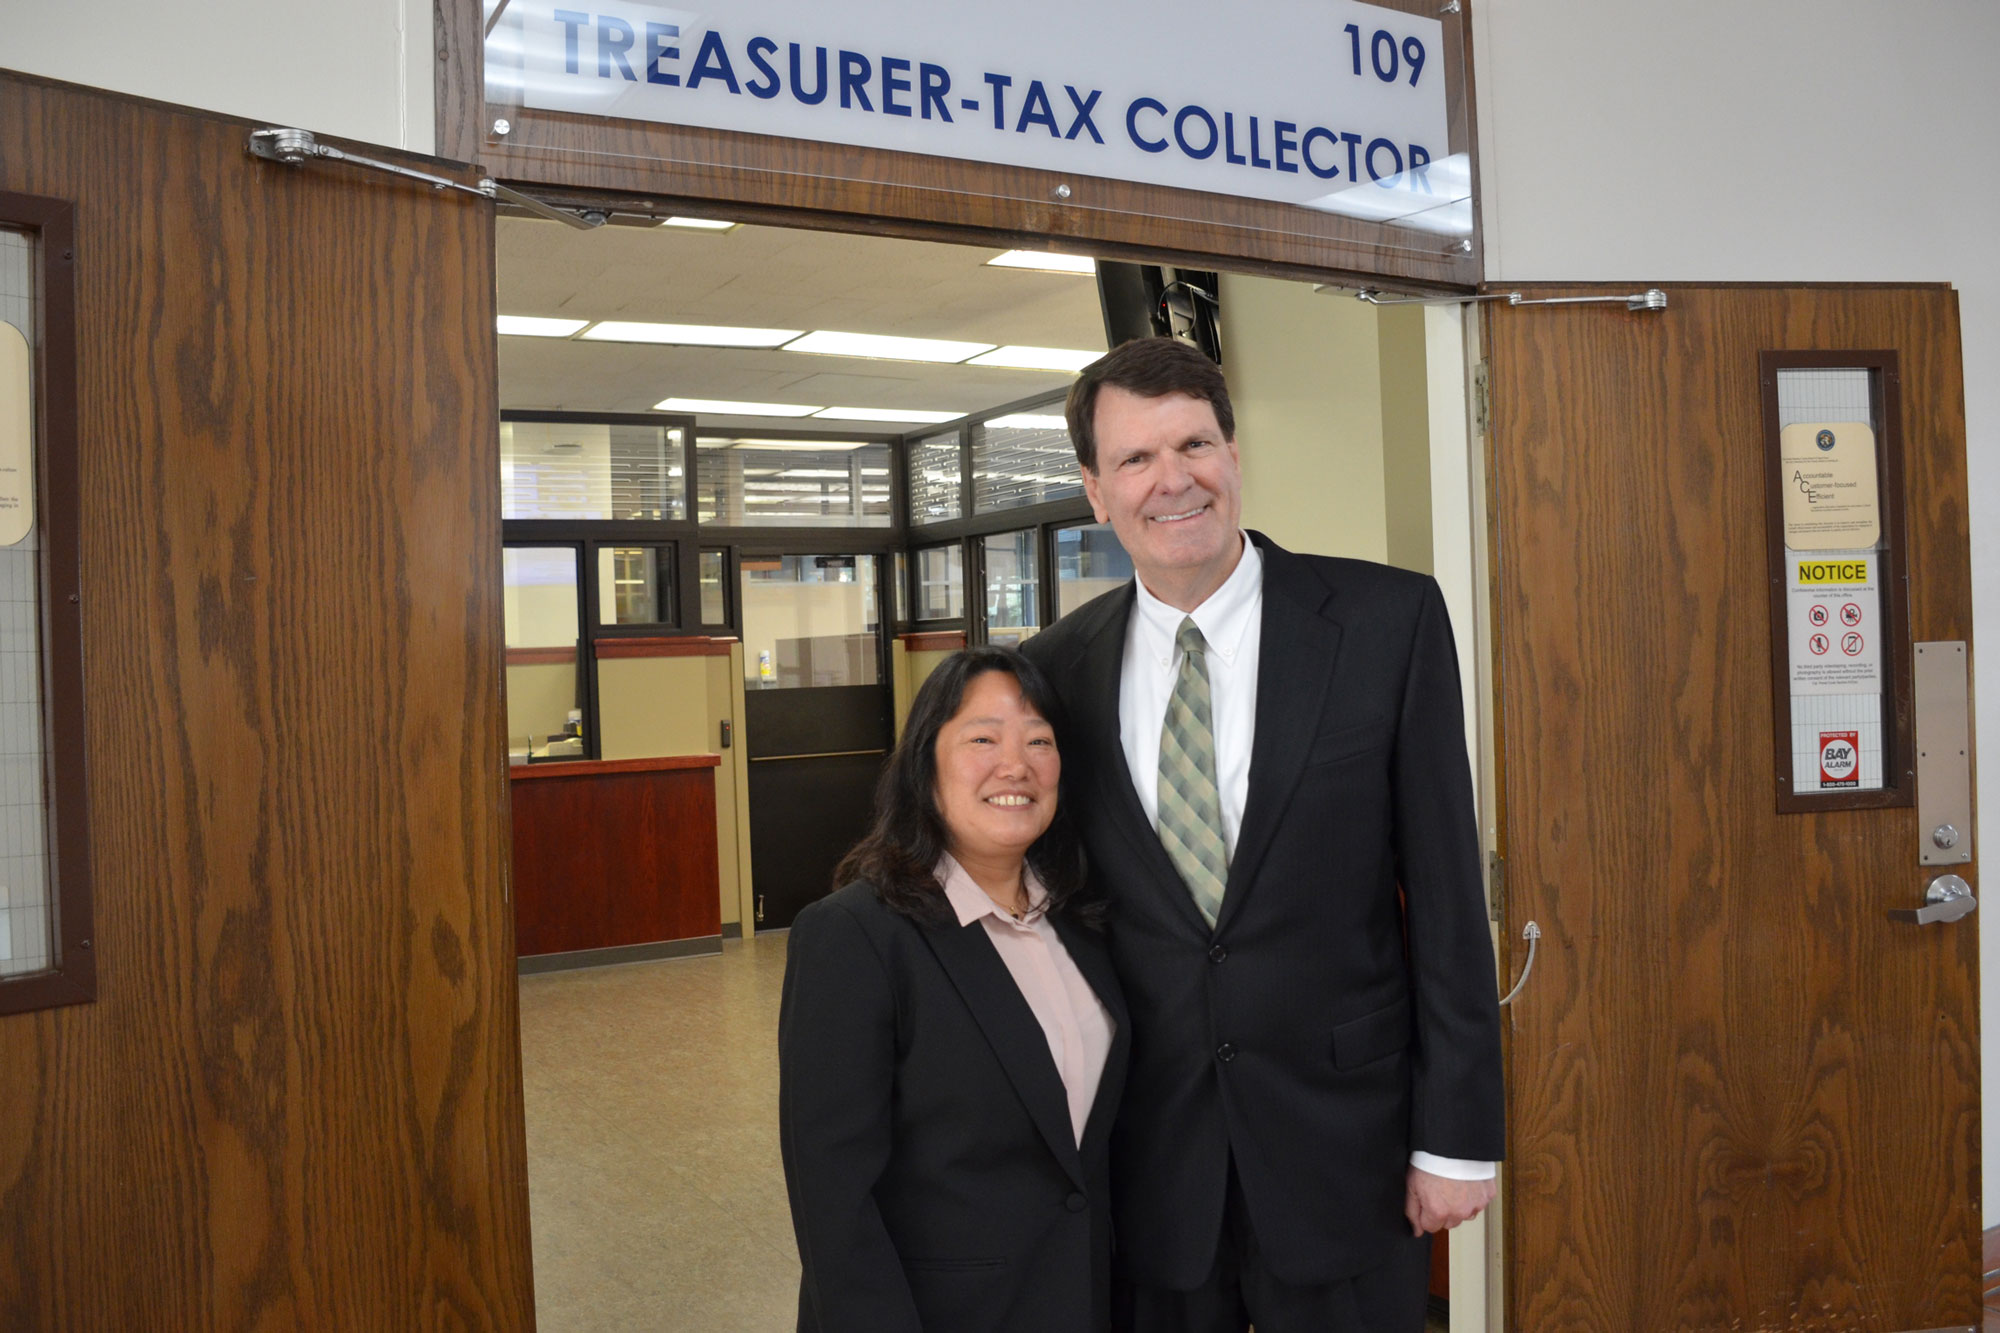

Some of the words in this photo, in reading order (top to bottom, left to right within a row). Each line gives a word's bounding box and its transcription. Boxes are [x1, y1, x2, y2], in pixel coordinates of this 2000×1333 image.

[1344, 23, 1426, 88] 109
[553, 8, 1105, 145] TREASURER-TAX
[1125, 96, 1432, 195] COLLECTOR
[1799, 564, 1866, 580] NOTICE
[1825, 748, 1852, 760] BAY
[1824, 761, 1852, 769] ALARM
